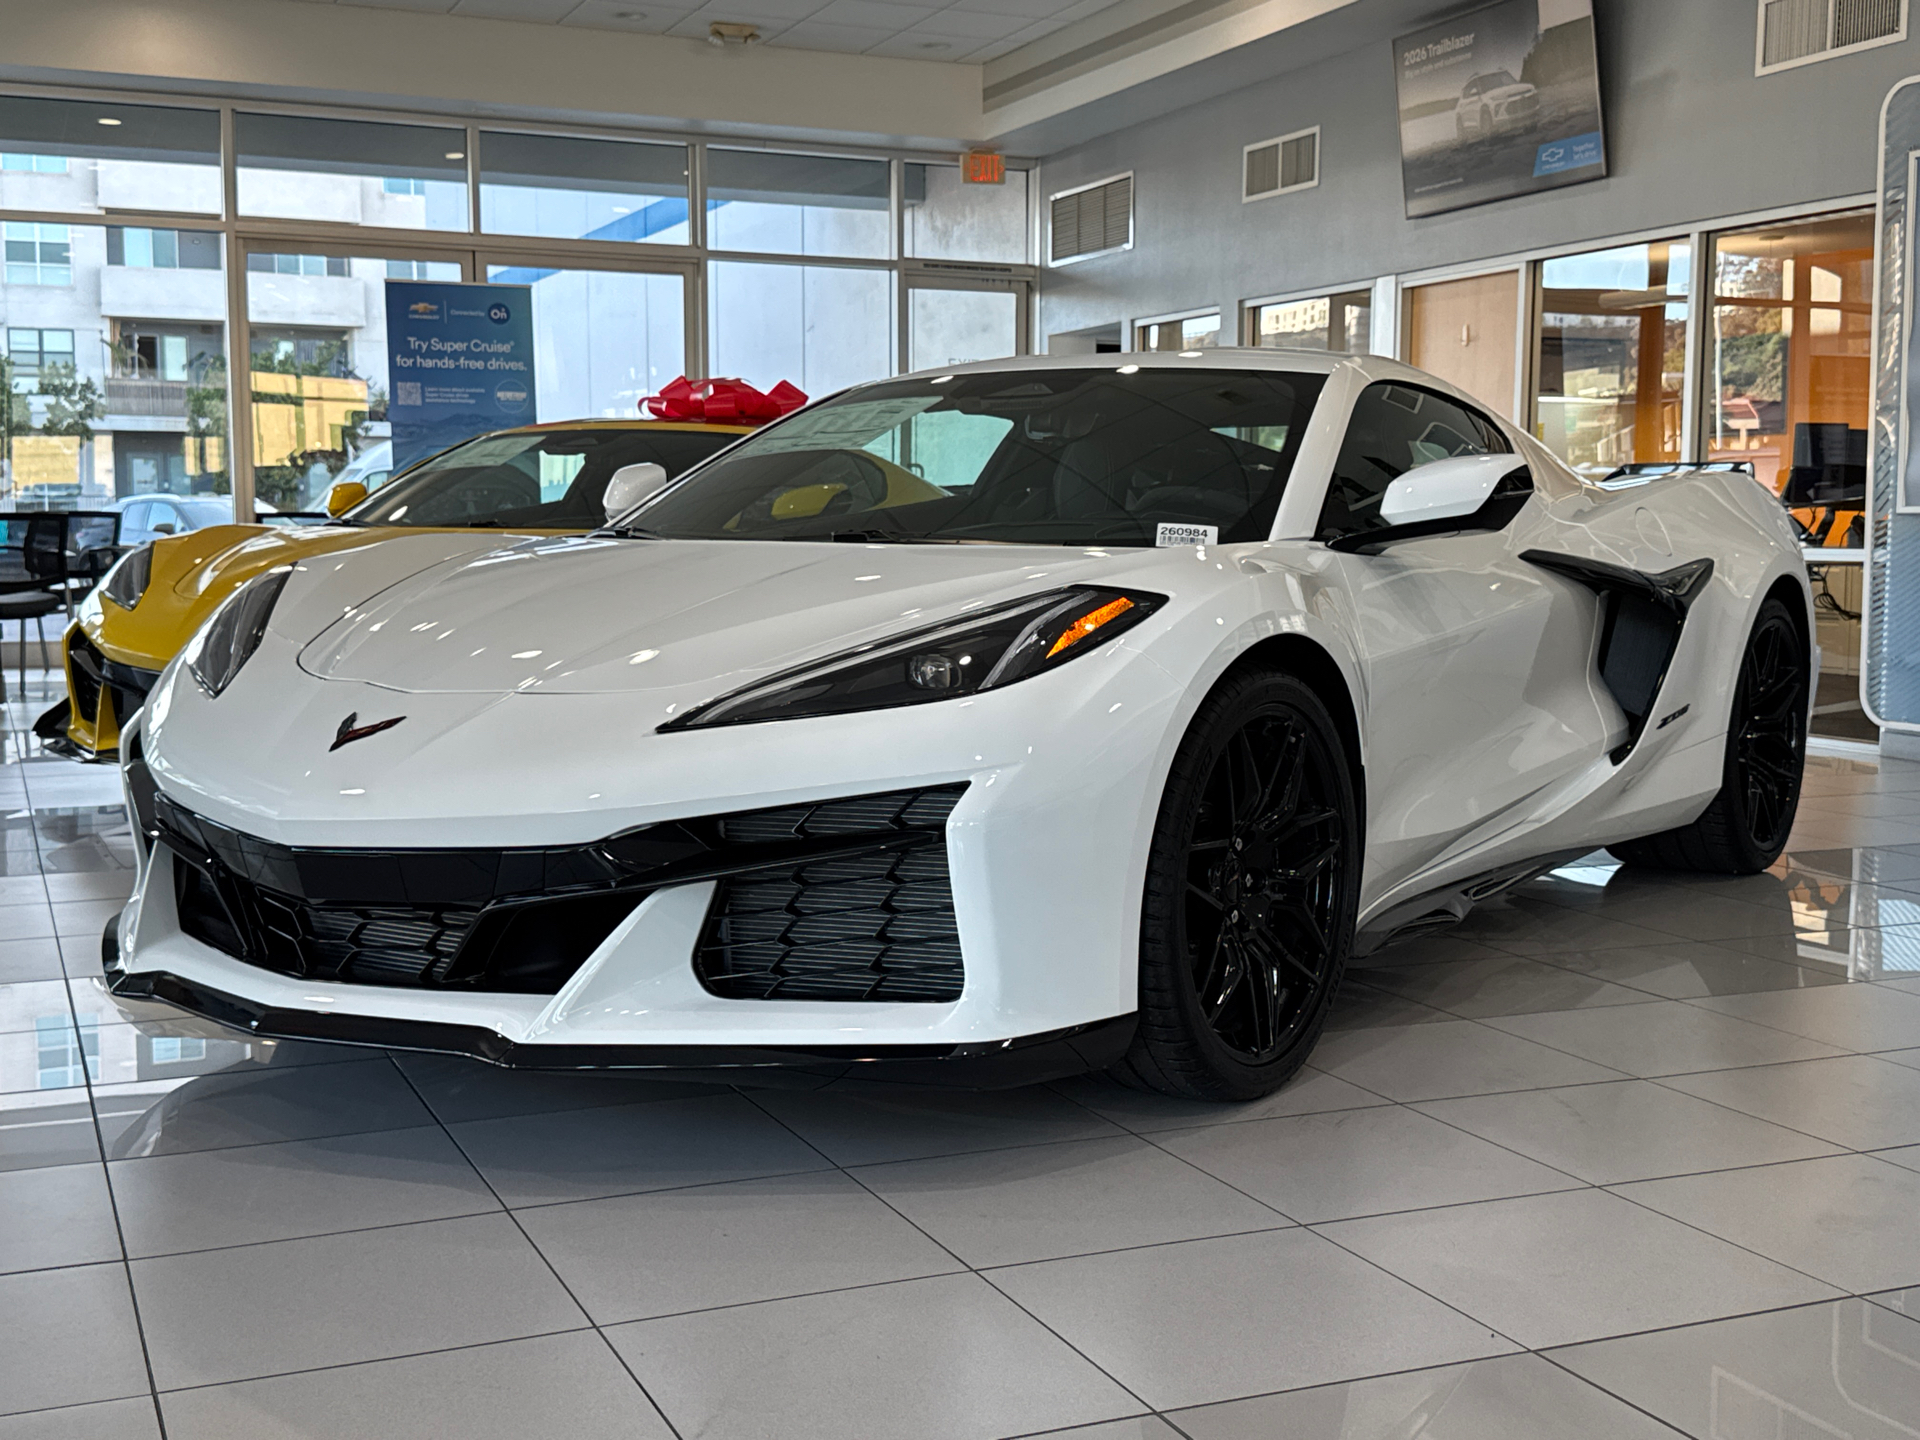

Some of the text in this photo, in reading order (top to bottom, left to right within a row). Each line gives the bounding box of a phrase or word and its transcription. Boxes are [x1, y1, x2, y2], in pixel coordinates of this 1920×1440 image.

[1403, 47, 1428, 66] 2026
[1427, 33, 1475, 58] Trailblazer
[970, 154, 999, 181] EXIT
[407, 337, 429, 353] Try
[430, 338, 469, 353] Super
[396, 354, 414, 367] for
[416, 355, 485, 370] hands-free
[1160, 527, 1208, 538] 260984
